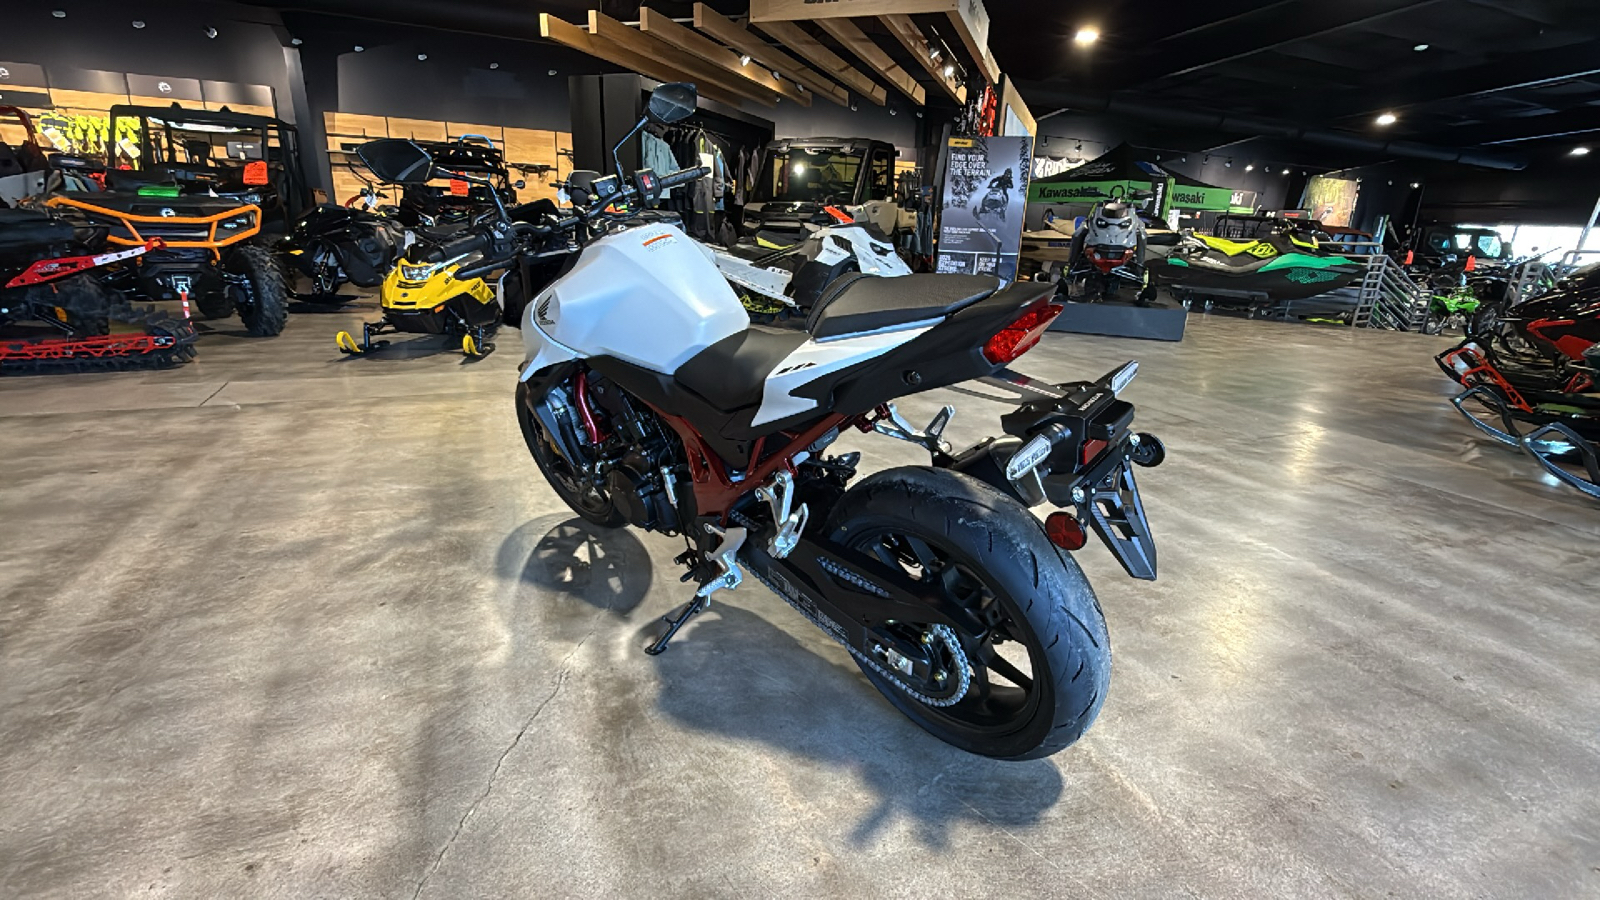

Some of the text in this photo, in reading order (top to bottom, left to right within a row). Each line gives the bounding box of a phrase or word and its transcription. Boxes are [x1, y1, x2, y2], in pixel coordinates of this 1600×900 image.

[951, 153, 985, 162] FIND YOUR
[950, 161, 967, 169] EDGE
[950, 168, 962, 176] THE
[1078, 392, 1104, 411] HONDA
